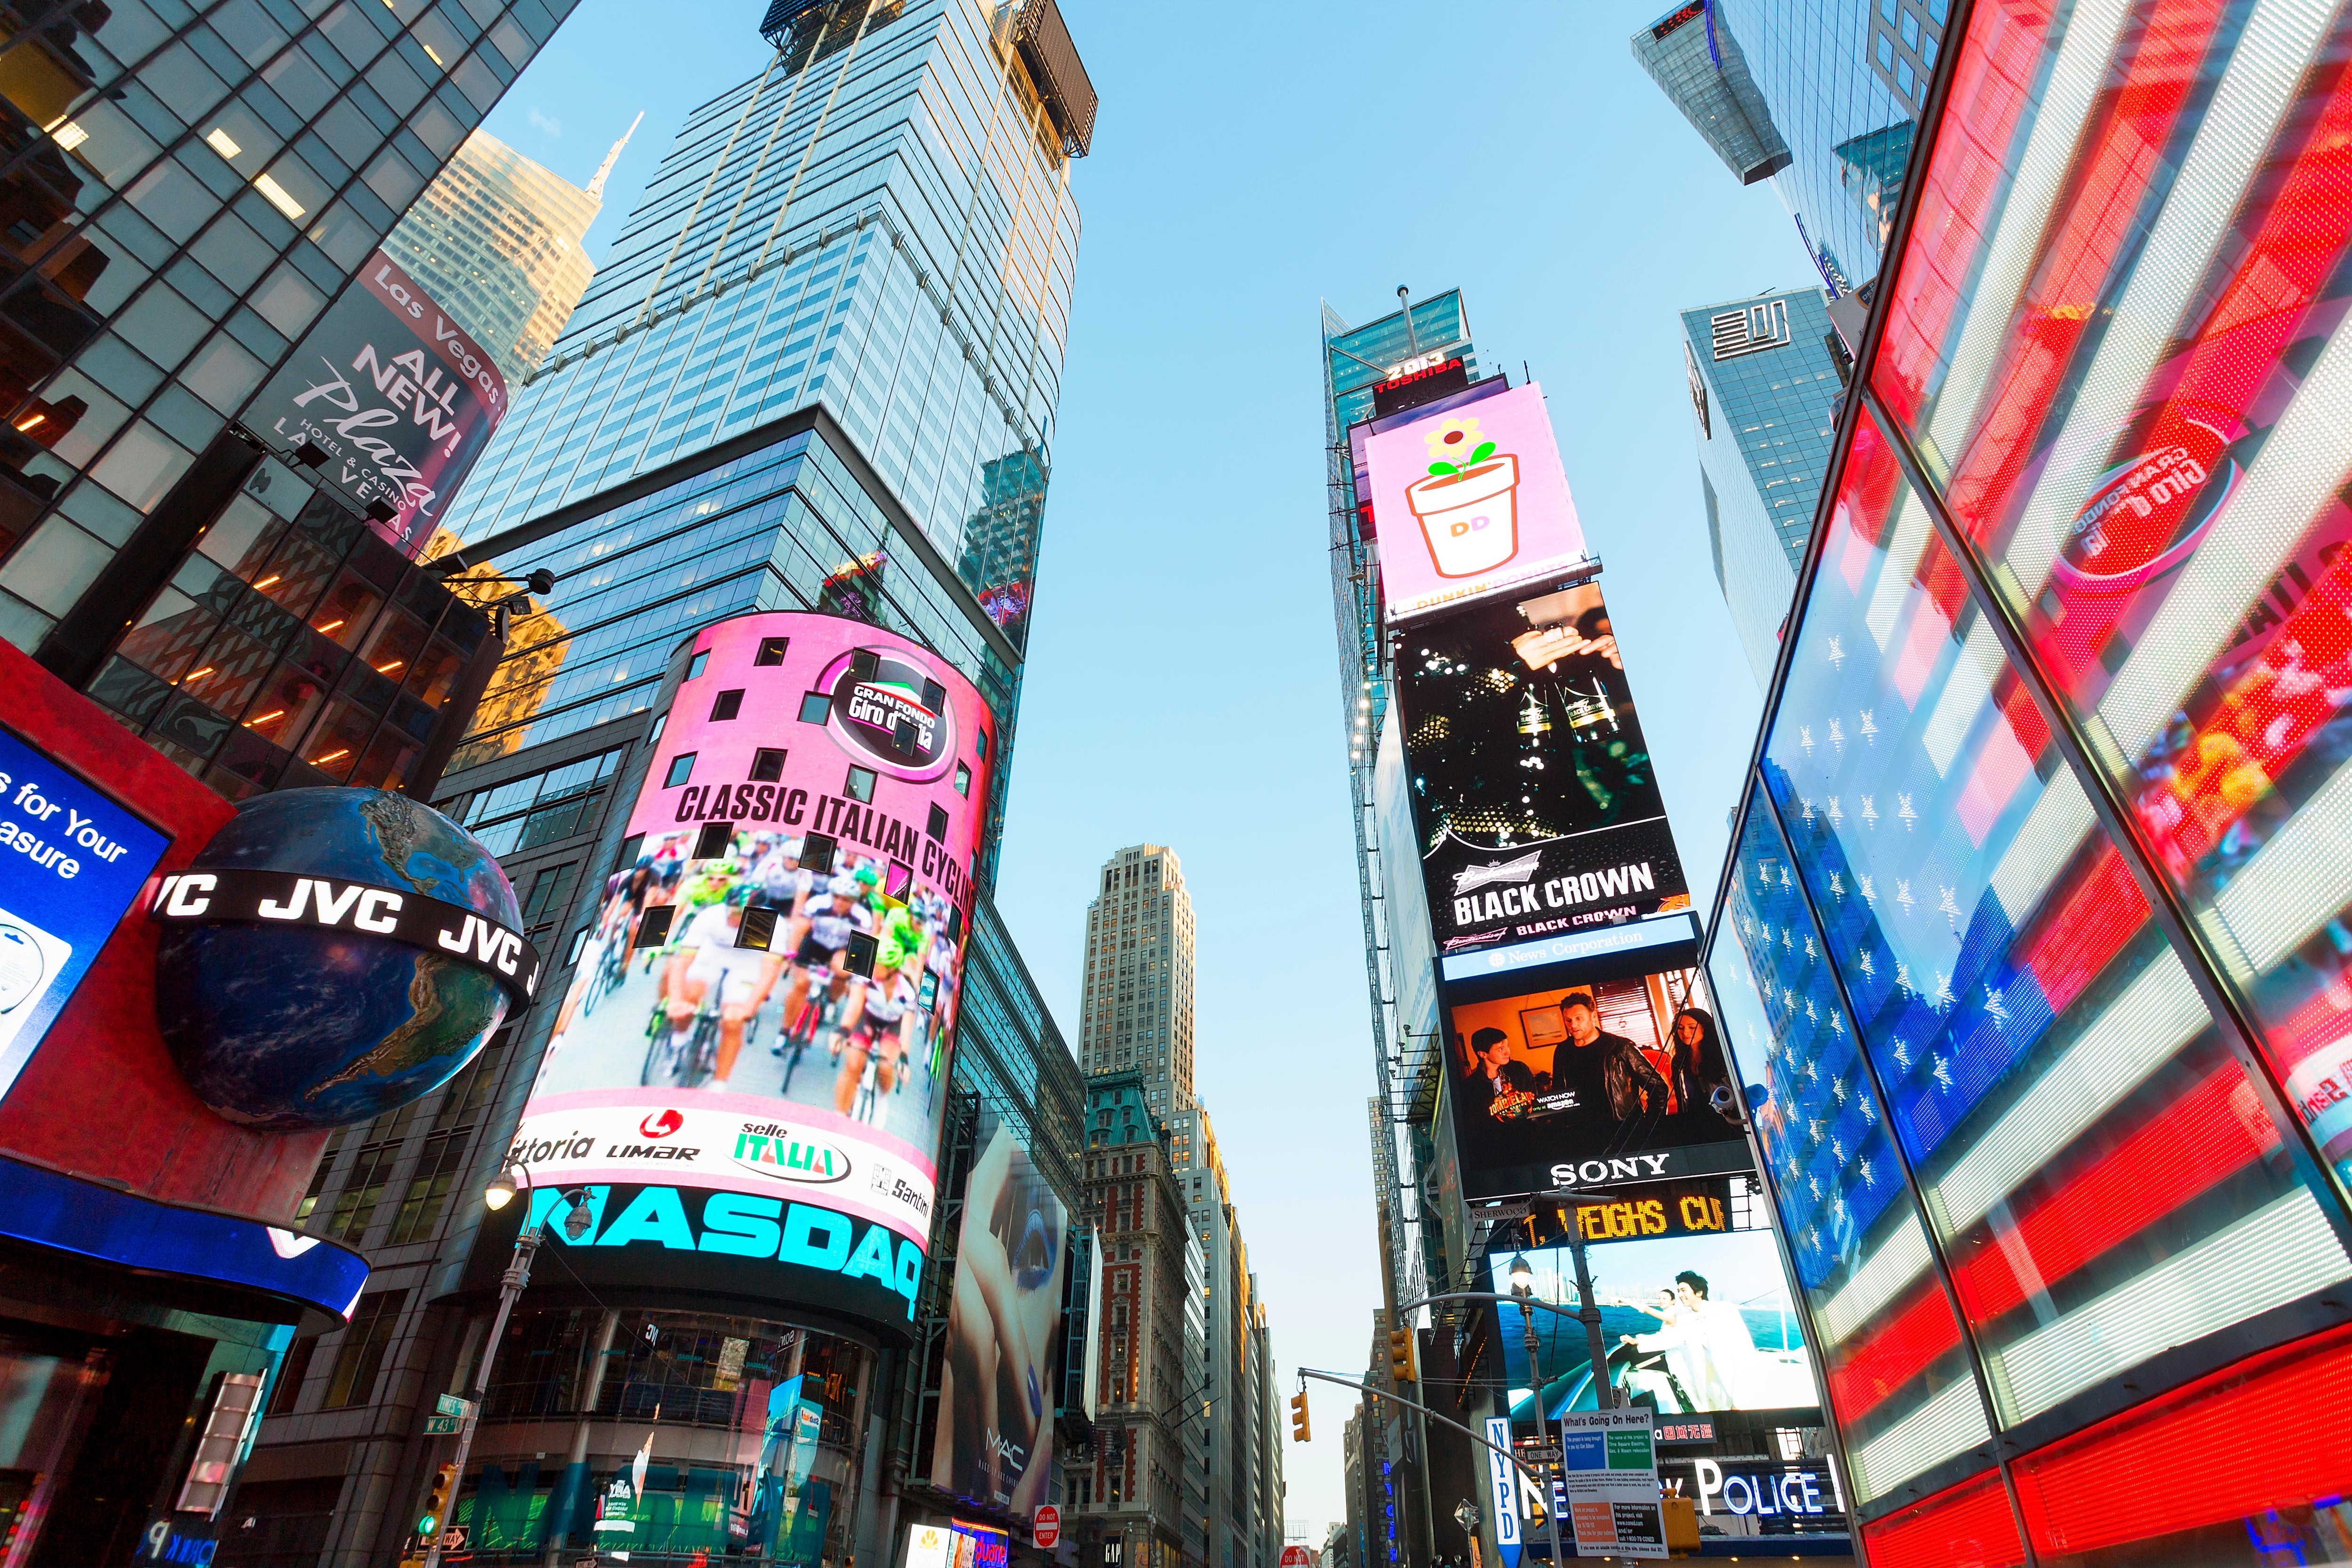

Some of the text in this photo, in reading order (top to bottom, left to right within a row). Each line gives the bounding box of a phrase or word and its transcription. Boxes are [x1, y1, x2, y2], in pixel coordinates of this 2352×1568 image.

[374, 264, 499, 404] Las Vegas
[392, 349, 458, 417] ALL
[1374, 358, 1462, 393] TOSHIBA
[1388, 351, 1446, 382] 2013
[351, 343, 462, 458] NEW!
[293, 356, 437, 517] Plaza
[273, 417, 412, 543] LA VEAS
[300, 418, 406, 511] HOTEL & CASINO
[1450, 516, 1490, 537] DD
[1417, 561, 1568, 610] DUNKIN' DONUTS
[849, 696, 884, 725] Giro
[854, 686, 936, 729] GRAN FONDO
[1569, 705, 1585, 717] BLACK
[12, 783, 128, 863] for Your
[675, 784, 808, 825] CLASSIC
[813, 794, 919, 866] ITALIAN
[0, 817, 80, 879] asure
[1453, 861, 1539, 886] Budweiser
[1454, 861, 1655, 925] BLACK CROWN
[153, 874, 522, 976] VC JVC JVC
[1443, 906, 1637, 947] Budweiser BLACK CROWN
[1508, 930, 1644, 964] News Corporation
[1489, 1091, 1535, 1116] ZOMBIELAND
[1537, 1091, 1575, 1104] WATCH NOW
[1547, 1098, 1574, 1109] amazon
[741, 1123, 787, 1138] selle
[734, 1133, 833, 1177] ITALIA
[1550, 1153, 1669, 1186] SONY
[892, 1178, 930, 1218] Santini
[1474, 1208, 1526, 1219] SHERWOOD
[514, 1185, 923, 1323] NASDAQ
[439, 1397, 456, 1413] TIMES
[1564, 1414, 1649, 1427] What's Going On Here?
[427, 1419, 436, 1432] W
[437, 1419, 449, 1432] 43
[1492, 1424, 1513, 1539] NYPD
[1694, 1458, 1823, 1516] POLICE
[445, 1534, 460, 1544] WAY
[1105, 1544, 1120, 1563] GAP
